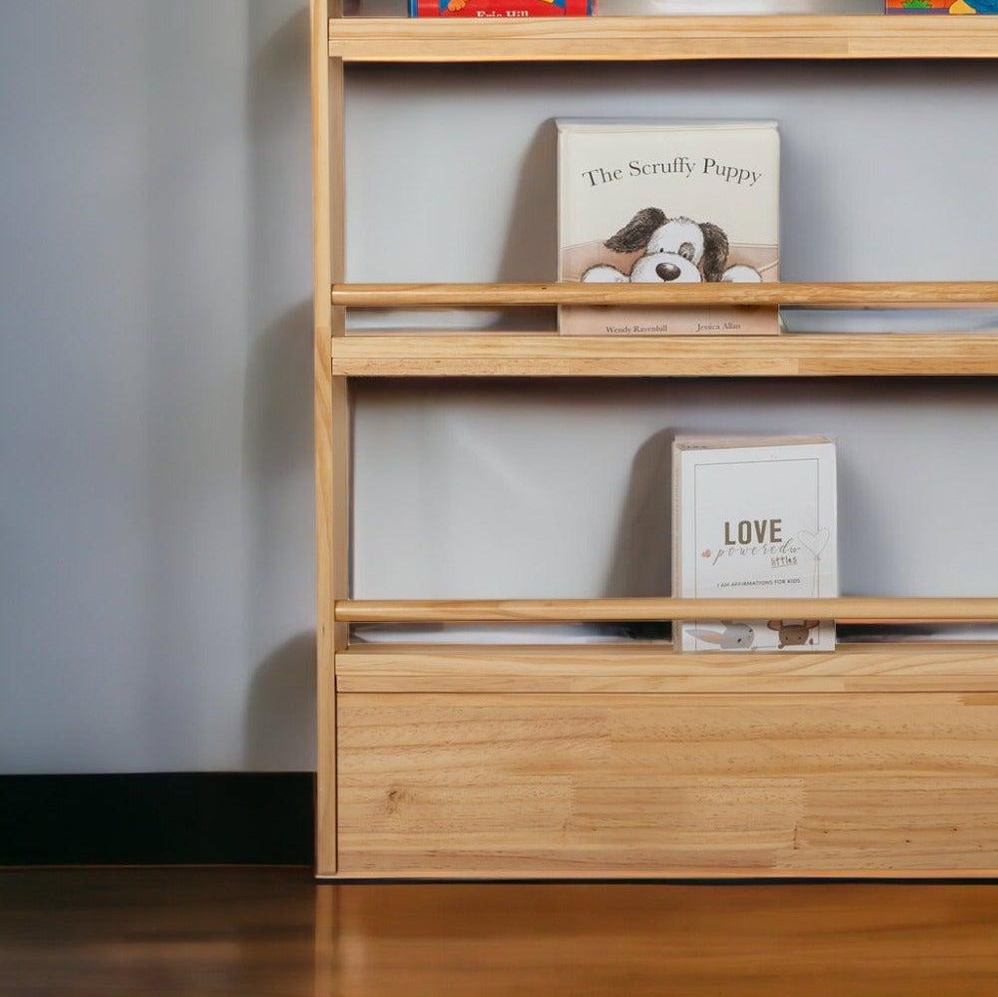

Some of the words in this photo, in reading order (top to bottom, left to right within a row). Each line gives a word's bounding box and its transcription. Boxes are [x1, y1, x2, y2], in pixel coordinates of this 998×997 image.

[581, 167, 623, 186] The
[628, 156, 697, 178] Scruffy
[702, 158, 763, 187] Puppy
[606, 326, 631, 334] Wendy
[724, 518, 782, 546] LOVE
